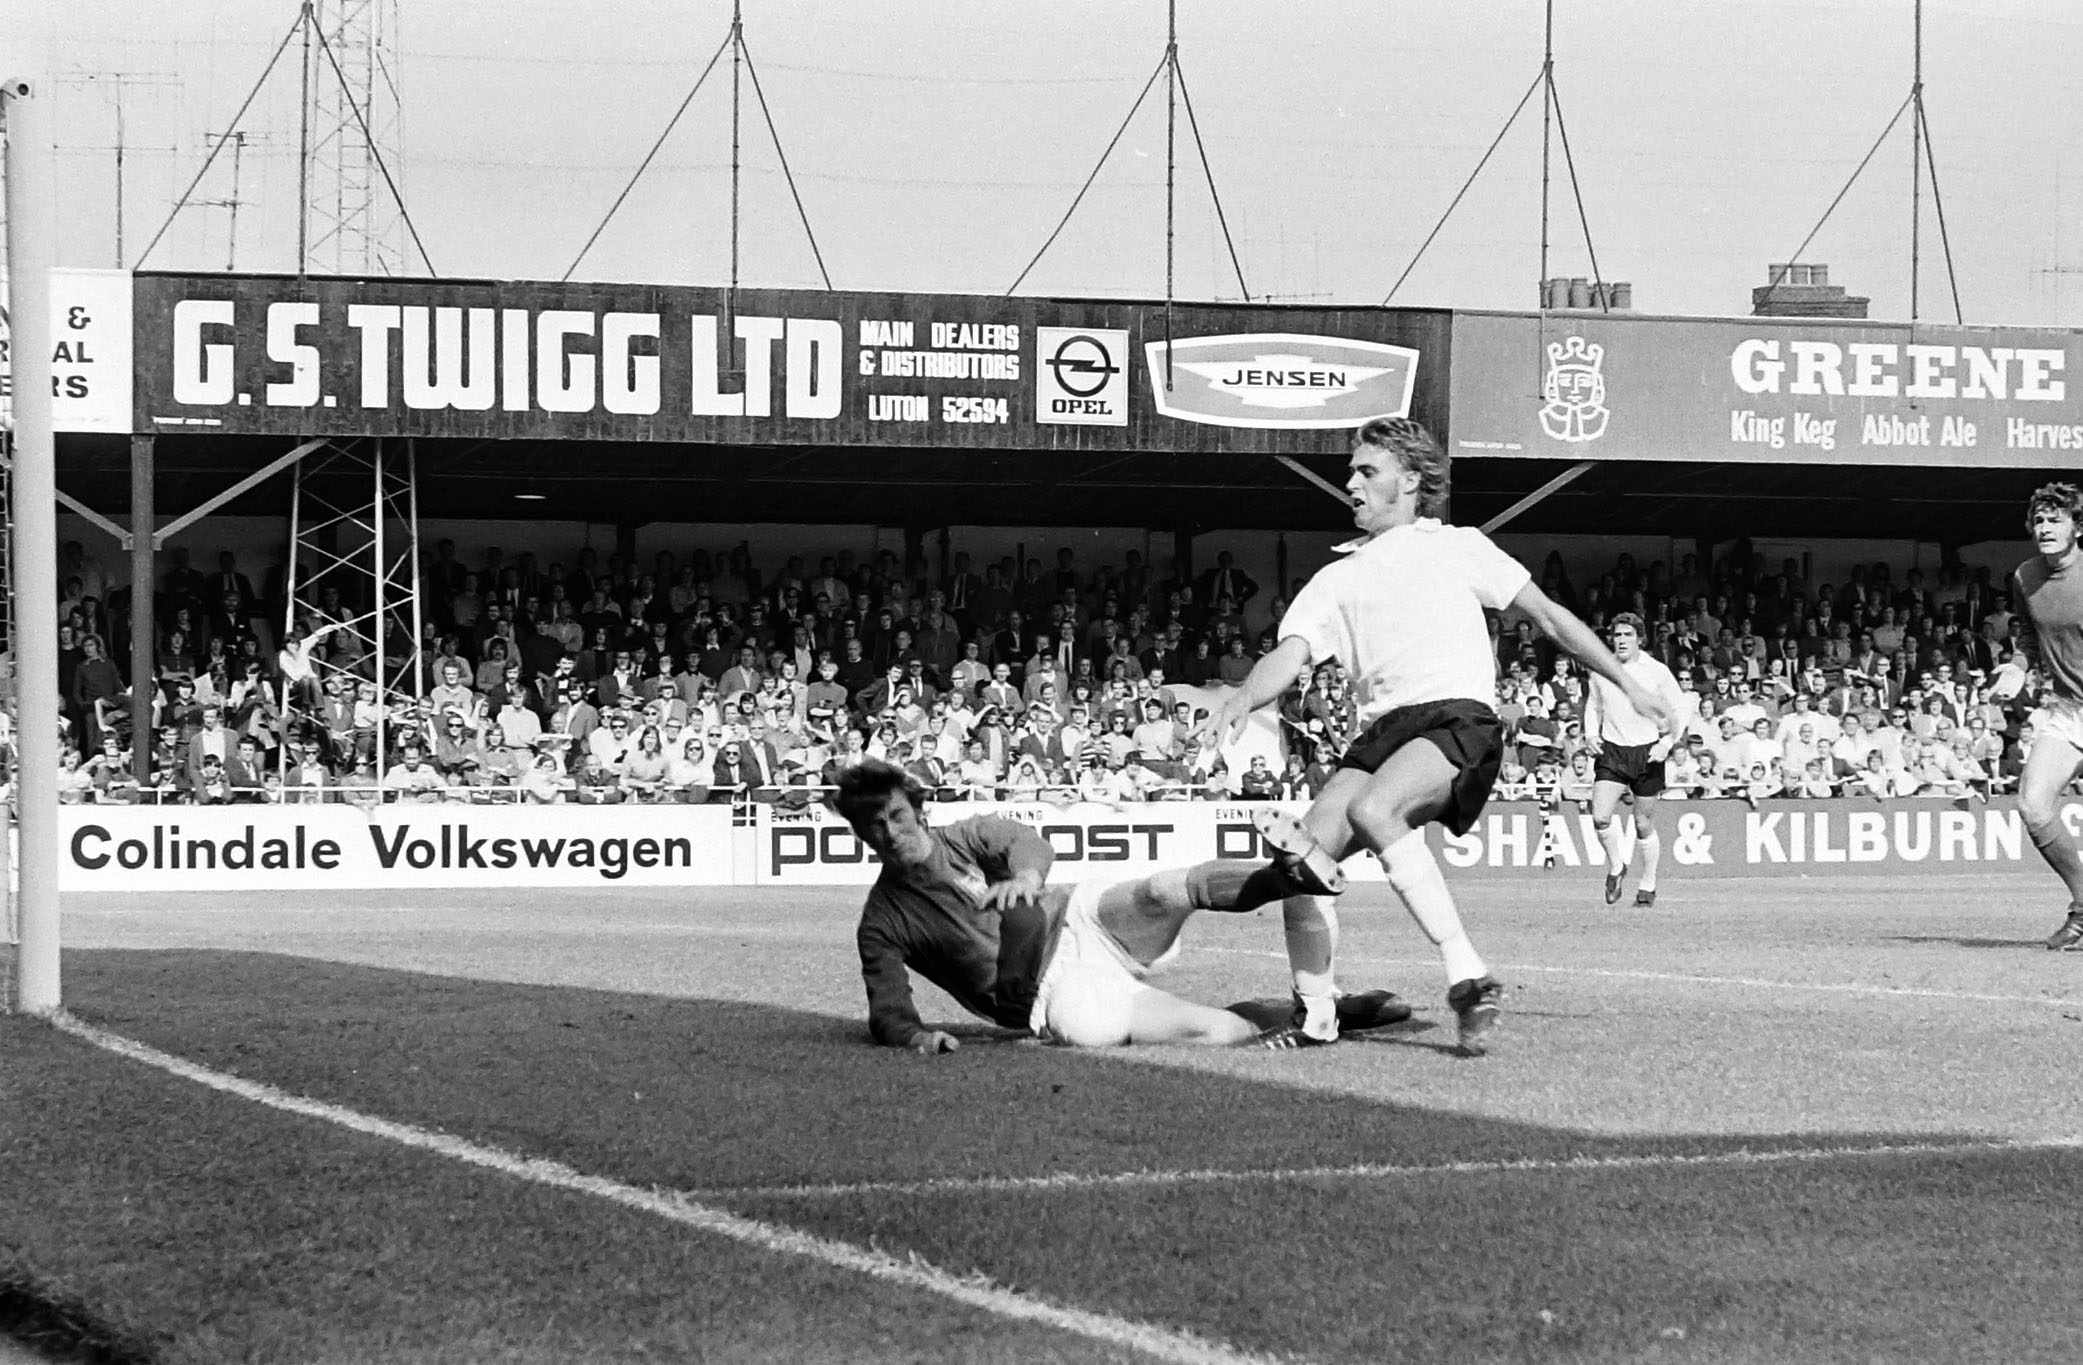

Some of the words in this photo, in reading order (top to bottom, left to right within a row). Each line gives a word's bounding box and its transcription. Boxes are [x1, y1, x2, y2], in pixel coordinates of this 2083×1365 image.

[68, 306, 91, 330] &
[859, 320, 914, 347] MAIN
[931, 322, 1019, 350] DEALERS
[348, 304, 660, 414] TWIGG
[692, 314, 842, 419] LTD
[859, 349, 876, 376] &
[881, 350, 1019, 380] DISTRIBUTORS
[1731, 339, 2065, 400] GREENE
[1222, 369, 1346, 387] JENSEN
[868, 395, 929, 421] LUTON
[942, 396, 1009, 424] 52594
[1052, 398, 1113, 416] OPEL
[1731, 410, 1785, 449] King
[1793, 411, 1837, 450] Keg
[1861, 414, 1931, 446] Abbot
[1940, 416, 1977, 447] Ale
[2006, 416, 2083, 449] Harves
[1001, 810, 1043, 821] VENING
[1216, 808, 1253, 819] EVENI
[70, 824, 342, 870] Colindale
[368, 824, 692, 879] Volkswagen
[1041, 824, 1174, 861] OST
[1673, 812, 1714, 864] &
[1745, 809, 2022, 864] KILBURN
